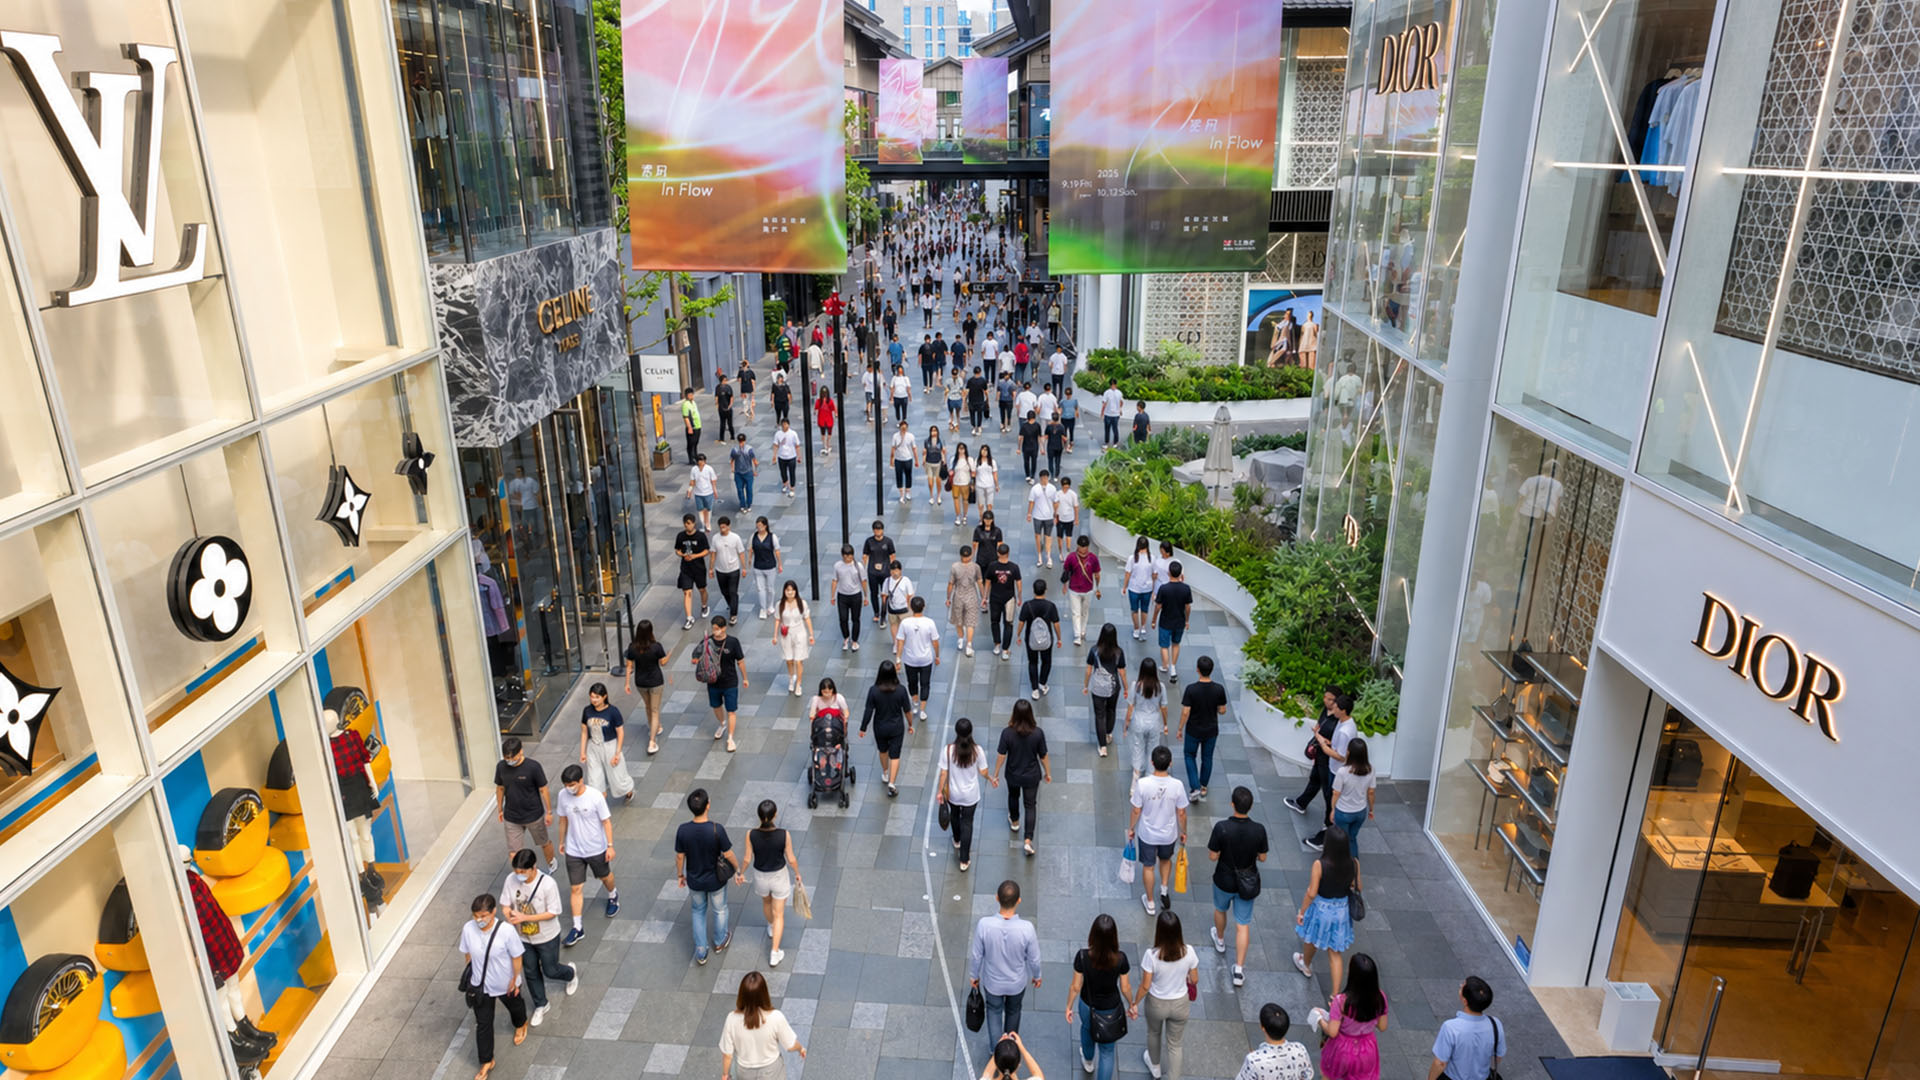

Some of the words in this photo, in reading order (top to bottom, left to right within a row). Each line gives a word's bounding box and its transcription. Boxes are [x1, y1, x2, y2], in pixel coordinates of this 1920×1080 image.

[1375, 21, 1441, 95] DIOR
[1209, 135, 1223, 150] In
[1227, 135, 1264, 150] Flow
[661, 182, 674, 196] In
[679, 182, 713, 197] Flow
[537, 285, 594, 334] CELINE
[1691, 590, 1846, 743] DIOR
